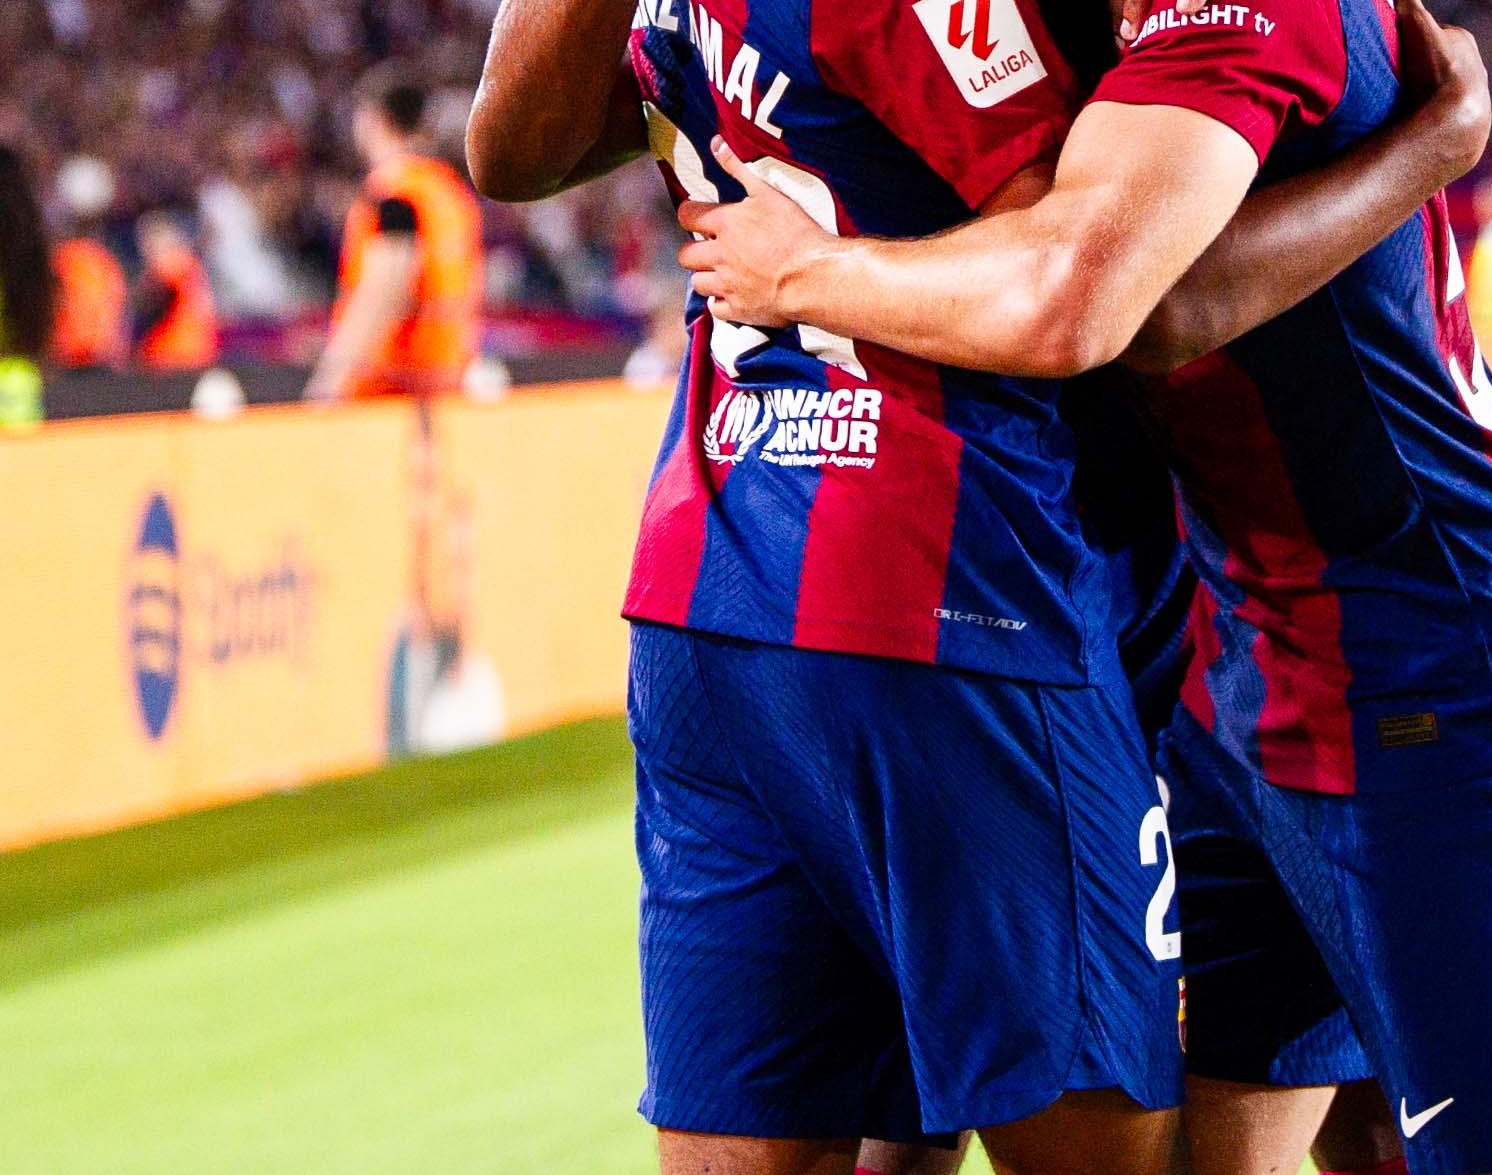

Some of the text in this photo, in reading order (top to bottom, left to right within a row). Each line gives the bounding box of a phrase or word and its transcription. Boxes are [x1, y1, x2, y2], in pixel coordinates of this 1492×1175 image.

[1254, 12, 1275, 36] tv
[968, 49, 1033, 93] LALIGA
[763, 418, 879, 454] ACNUR
[827, 453, 876, 469] Agency
